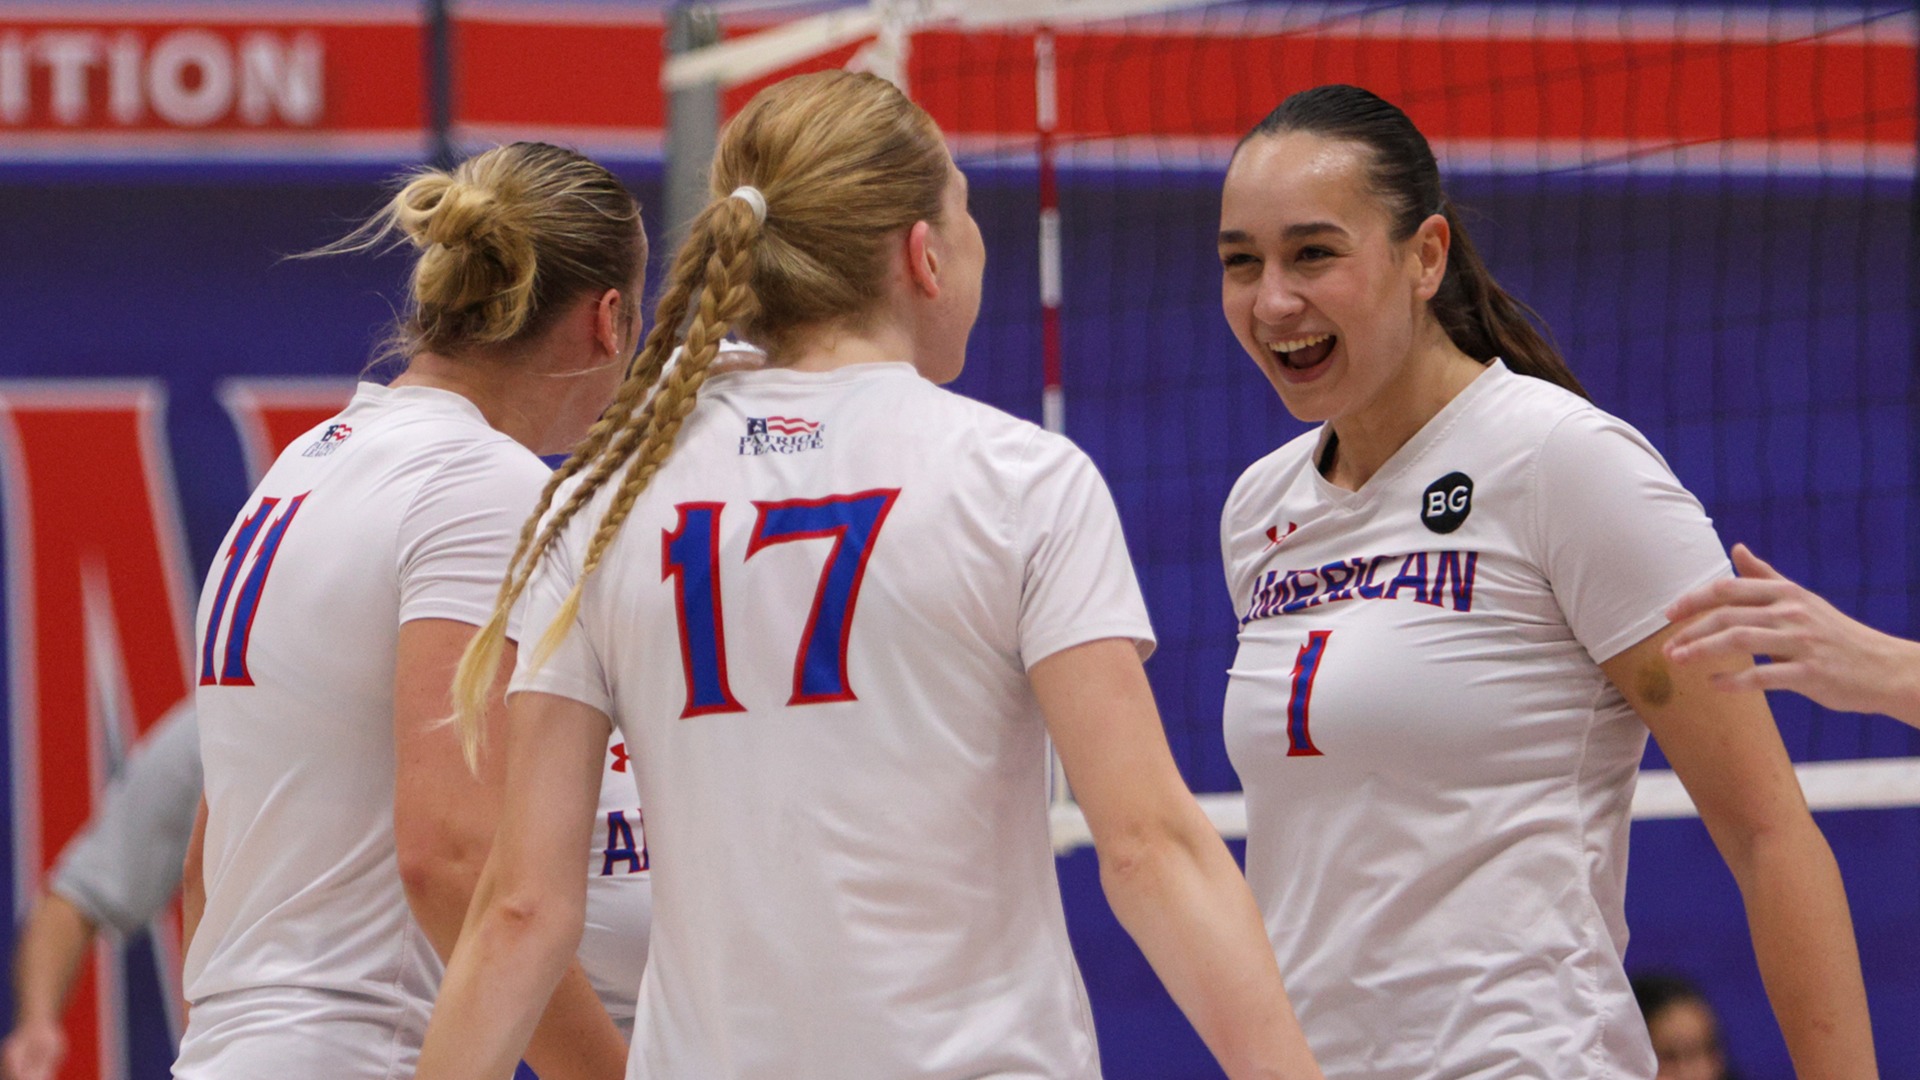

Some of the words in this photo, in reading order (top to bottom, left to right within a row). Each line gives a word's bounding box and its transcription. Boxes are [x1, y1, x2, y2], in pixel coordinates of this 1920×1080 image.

[0, 30, 326, 127] ITION
[737, 439, 824, 456] LEAGUE
[739, 428, 821, 447] PATRIOT
[1426, 485, 1469, 517] BG
[199, 489, 313, 686] 11
[661, 487, 902, 720] 17
[1286, 629, 1334, 757] 1
[599, 808, 650, 876] A
